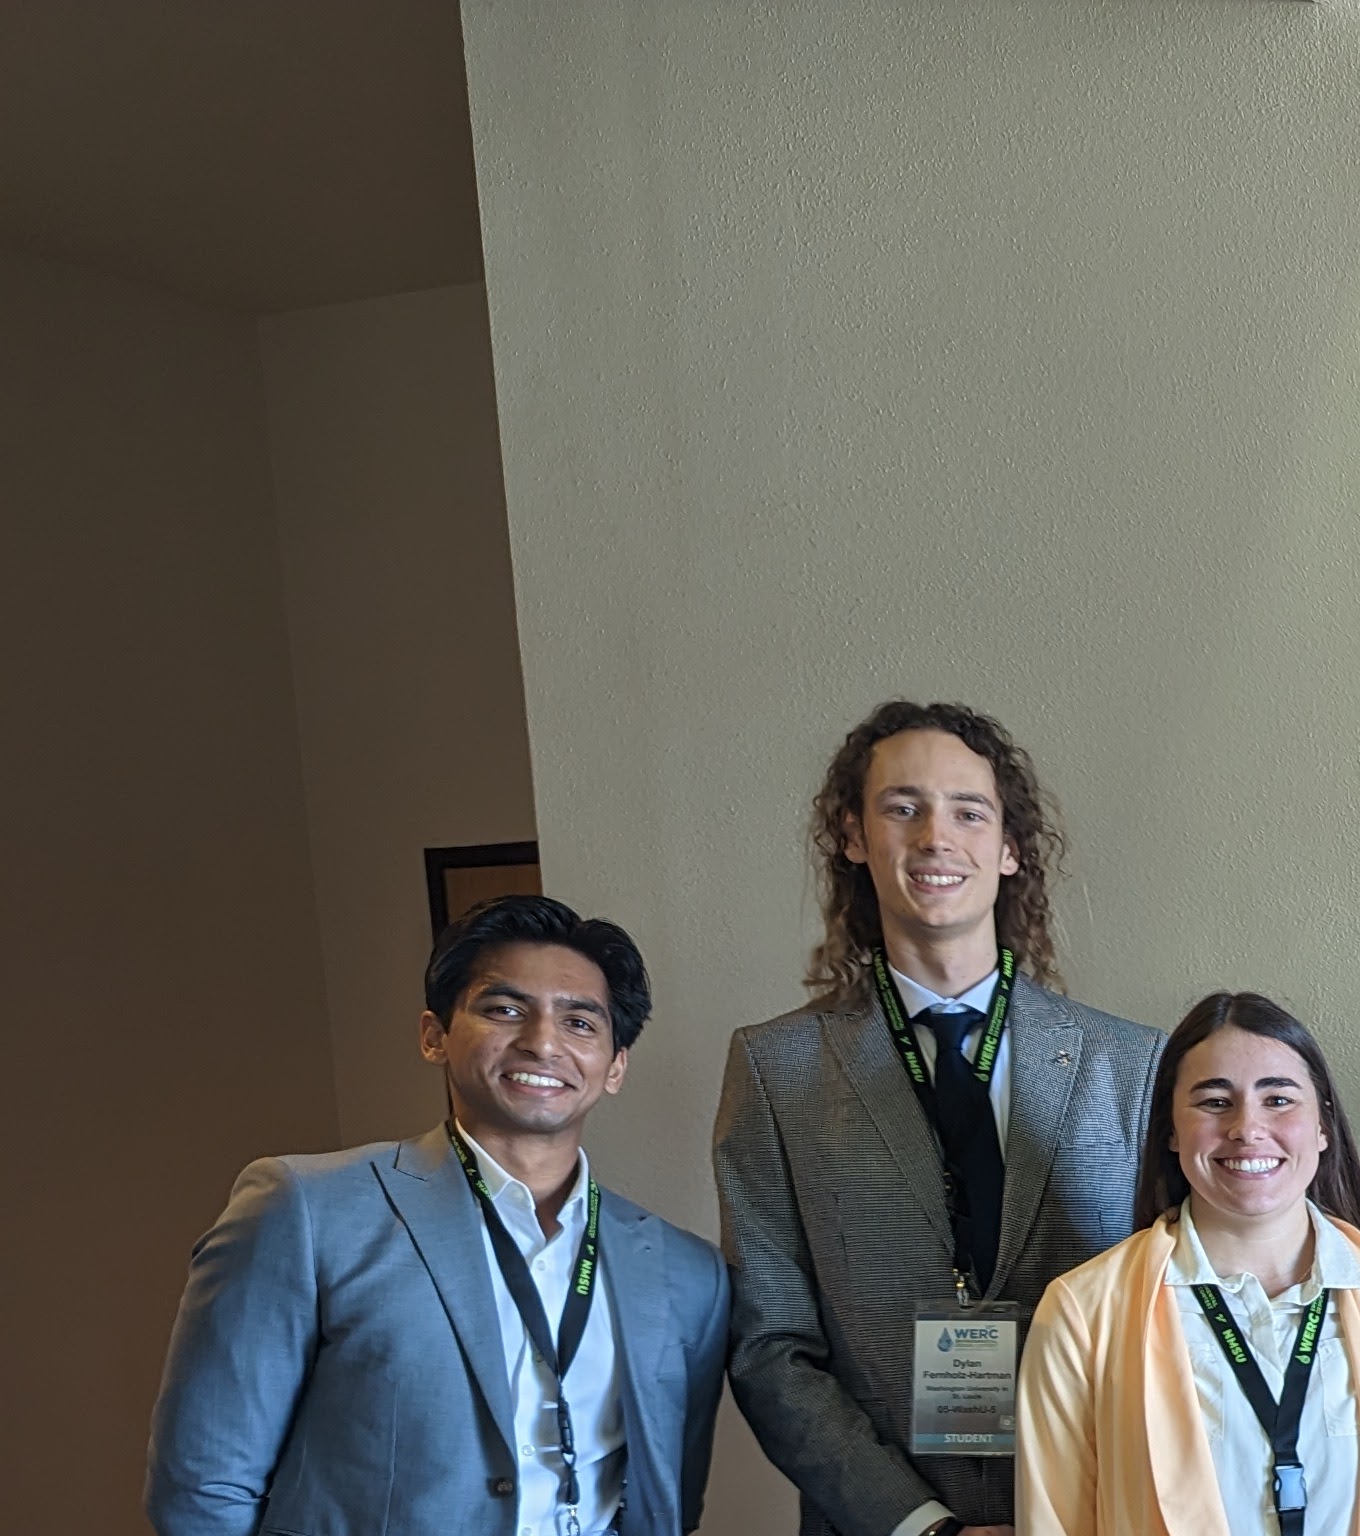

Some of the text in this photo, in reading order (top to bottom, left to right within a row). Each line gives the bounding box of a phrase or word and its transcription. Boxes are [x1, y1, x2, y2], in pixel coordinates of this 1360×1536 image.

[978, 1035, 998, 1071] WERC
[576, 1259, 593, 1295] NMSU
[954, 1328, 998, 1339] WERC
[1222, 1328, 1247, 1363] NMSU
[1299, 1312, 1320, 1352] WERC
[944, 1433, 994, 1443] STUDENT
